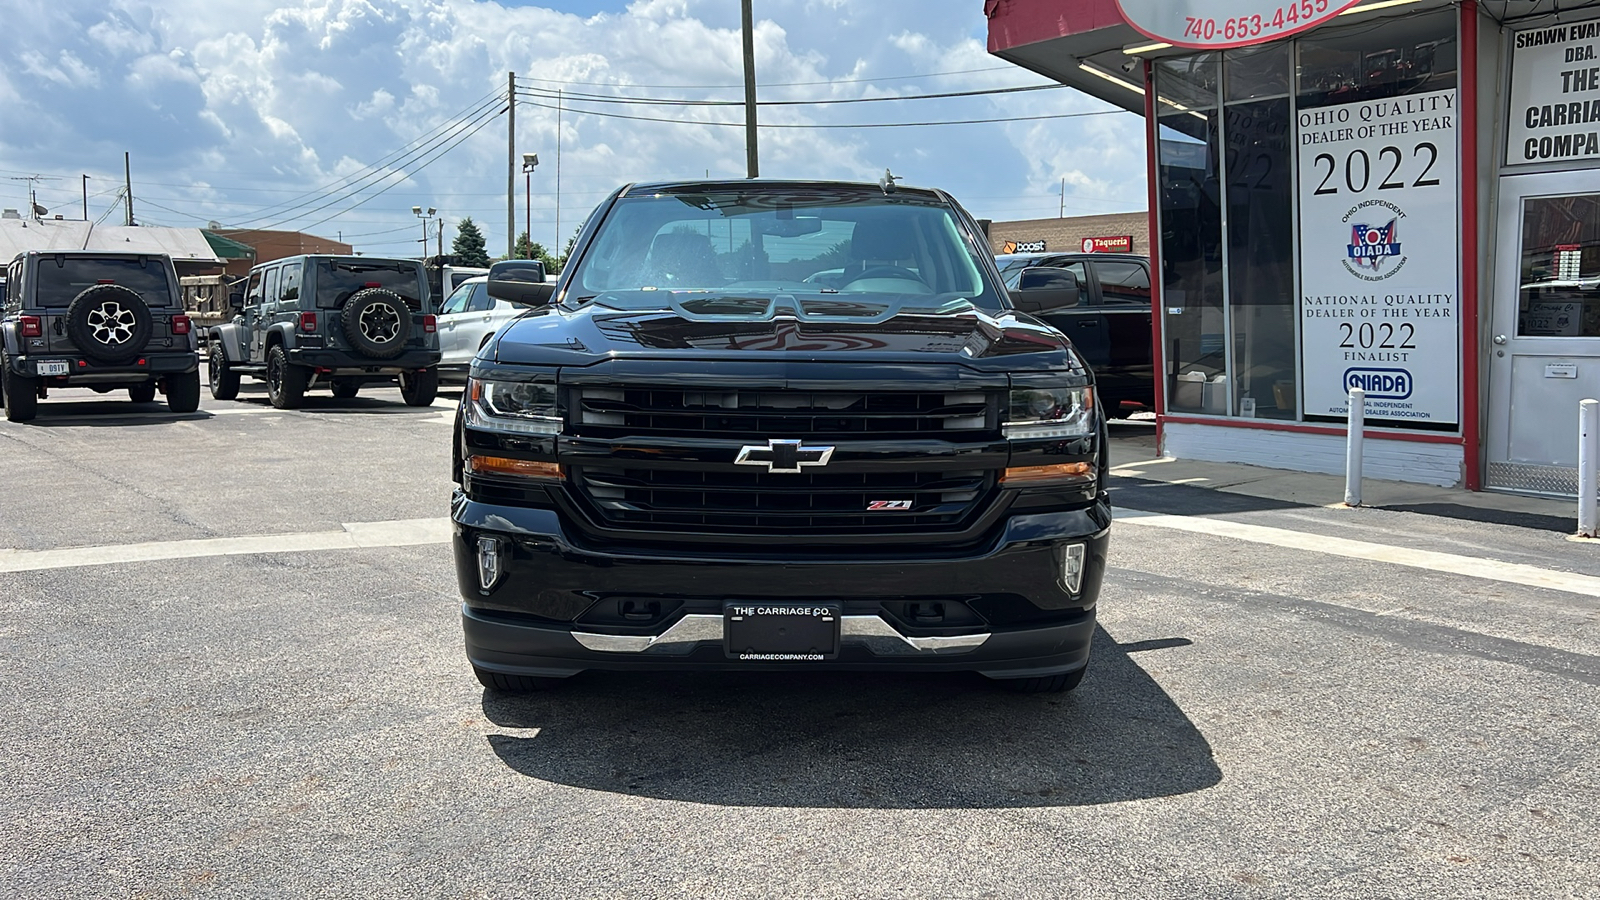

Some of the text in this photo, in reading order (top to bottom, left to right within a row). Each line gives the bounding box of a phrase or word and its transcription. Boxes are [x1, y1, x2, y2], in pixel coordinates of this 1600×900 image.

[1184, 0, 1329, 40] 740-653-4455
[1516, 27, 1567, 49] SHAWN
[1565, 45, 1598, 63] DBA.
[1560, 67, 1600, 93] THE
[1300, 109, 1349, 127] OHIO
[1359, 94, 1455, 122] QUALITY
[1302, 128, 1354, 145] DEALER
[1357, 125, 1376, 138] OF
[1379, 121, 1408, 136] THE
[1412, 116, 1452, 132] YEAR
[1313, 142, 1440, 196] 2022
[1341, 200, 1407, 223] OHIO INDEPENDENT
[1017, 240, 1045, 252] boost
[1094, 237, 1127, 247] Taqueria
[1353, 244, 1392, 257] OIADA
[1384, 256, 1408, 279] ASSOCIATION
[1305, 294, 1453, 307] NATIONAL QUALITY
[1306, 308, 1451, 318] DEALER OF THE YEAR
[1339, 322, 1416, 349] 2022
[1344, 352, 1409, 362] FINALIST
[1373, 401, 1413, 409] INDEPENDENT
[1390, 410, 1431, 418] ASSOCIATION
[867, 500, 912, 510] Z71
[734, 607, 831, 616] THE CARRIAGE CO.
[740, 653, 824, 661] CARRIAGECOMPANY.COM
